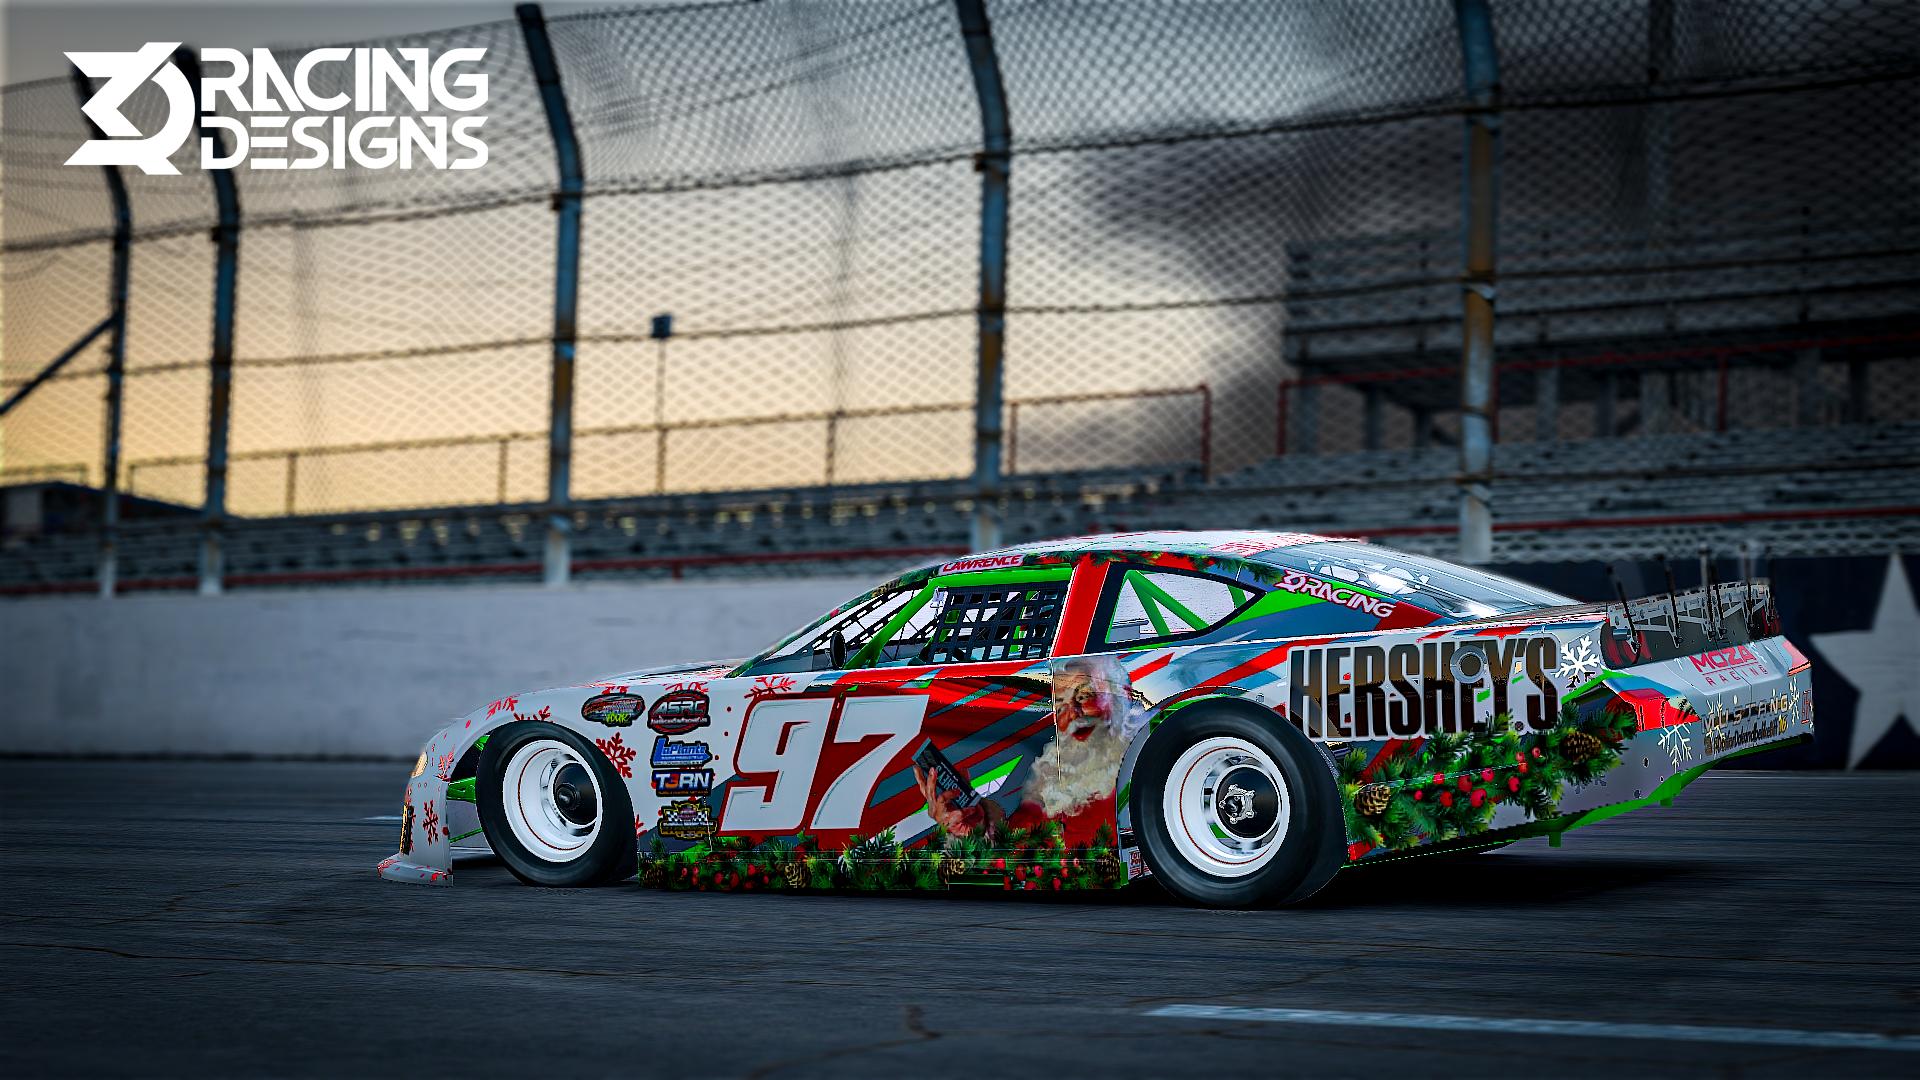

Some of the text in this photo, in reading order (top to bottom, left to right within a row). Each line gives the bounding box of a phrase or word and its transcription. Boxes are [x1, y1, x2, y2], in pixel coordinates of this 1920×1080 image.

[943, 554, 1024, 572] LAWRENCE
[1301, 578, 1396, 618] RACING
[1689, 645, 1756, 673] MOZA
[1705, 664, 1769, 686] RACING
[655, 700, 705, 714] ASRC
[1701, 694, 1788, 734] MUSTANG
[721, 694, 930, 832] 97
[655, 772, 710, 789] T3RN
